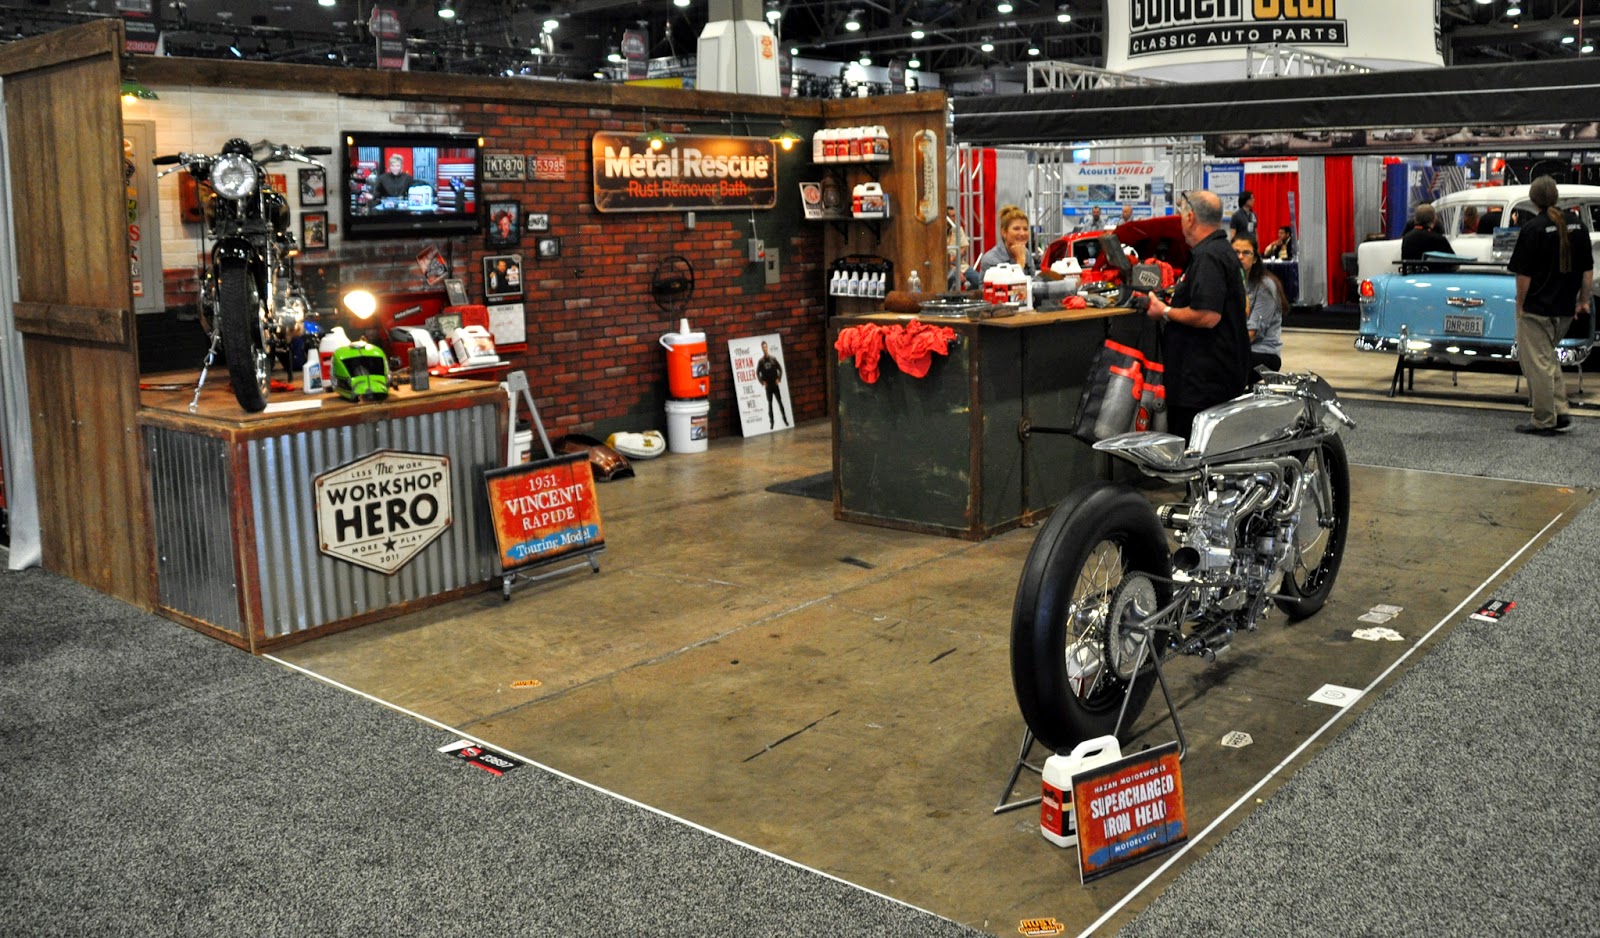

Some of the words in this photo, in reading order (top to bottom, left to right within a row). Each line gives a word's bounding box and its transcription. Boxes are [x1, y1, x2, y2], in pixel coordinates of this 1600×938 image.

[1132, 33, 1197, 51] CLASSIC
[1207, 30, 1260, 44] AUTO
[1272, 28, 1338, 40] PARTS
[531, 160, 565, 171] 353985
[604, 146, 679, 178] Metal
[682, 148, 768, 179] Rescue
[1078, 165, 1154, 176] AcoustiSHIELD
[628, 180, 660, 198] Rust
[662, 181, 718, 198] Remover
[719, 180, 749, 197] Bath
[735, 357, 754, 370] BRYAN
[737, 370, 757, 383] FULLER
[351, 470, 372, 478] LESS
[374, 463, 394, 475] The
[397, 462, 423, 470] WORK
[326, 472, 443, 506] WORKSHOP
[529, 474, 558, 492] 1951
[505, 483, 583, 516] VINCENT
[335, 493, 439, 542] HERO
[522, 506, 576, 531] RAPIDE
[352, 543, 378, 554] MORE
[400, 534, 422, 545] PLAY
[516, 539, 559, 557] Touring
[561, 529, 591, 545] Model
[380, 553, 399, 563] 2011
[1094, 781, 1118, 794] HAZAN
[1120, 764, 1167, 785] MOTORWORKS
[1090, 774, 1175, 819] SUPERCHARGED
[1103, 812, 1132, 840] IRON
[1135, 799, 1167, 828] HEAD
[1114, 831, 1158, 853] MOTORCYCLE
